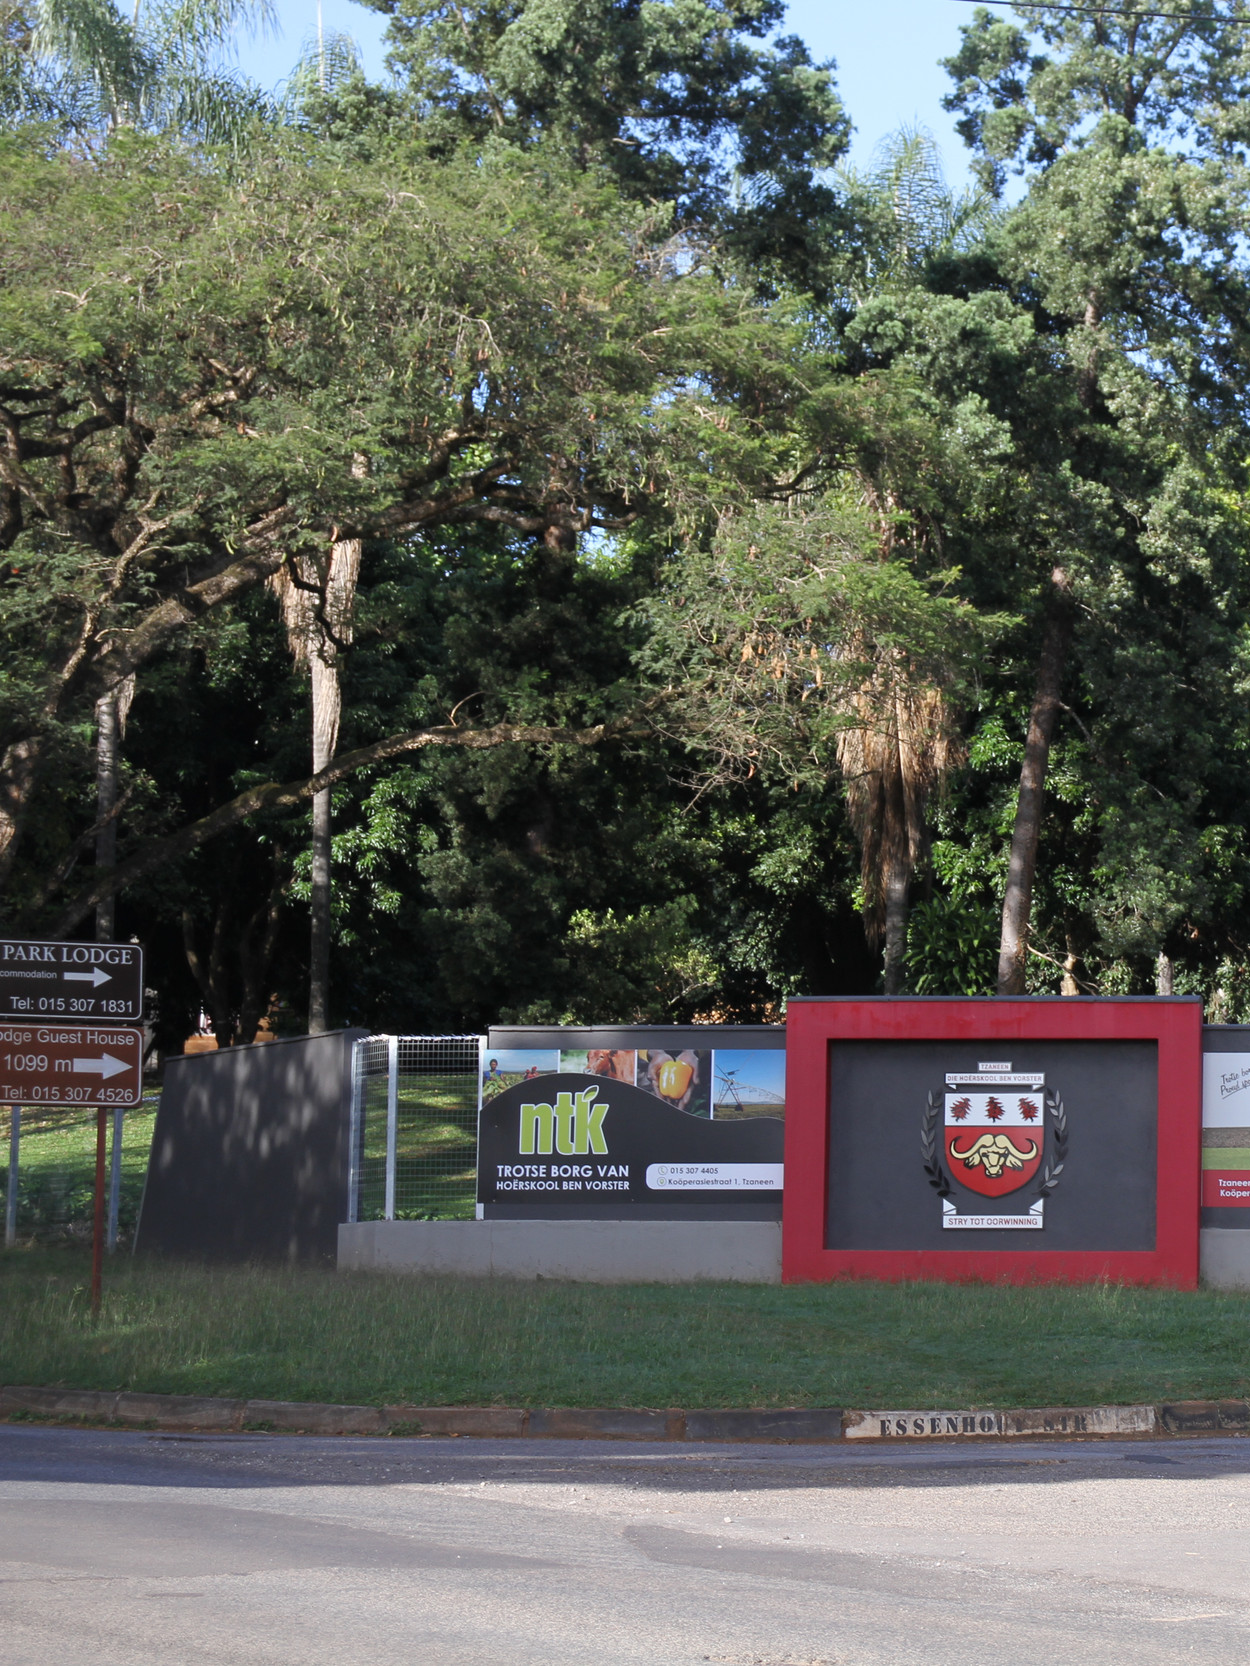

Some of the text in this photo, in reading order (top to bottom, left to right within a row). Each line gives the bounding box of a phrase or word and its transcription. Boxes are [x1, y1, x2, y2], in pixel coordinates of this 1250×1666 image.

[3, 945, 133, 965] PARK LODGE
[10, 996, 133, 1013] Tel: 015 307 1831
[37, 1030, 82, 1044] Guest
[87, 1031, 135, 1046] House
[4, 1054, 72, 1072] 1099 m
[2, 1085, 134, 1102] Tel: 015 307 4526
[519, 1085, 610, 1156] ntk
[497, 1165, 629, 1177] TROTSE BORG VAN
[701, 1167, 719, 1175] 4405
[496, 1179, 630, 1190] HOËRSKOOL BEN VORSTER
[948, 1218, 1038, 1226] STRY TOT OORWINNING
